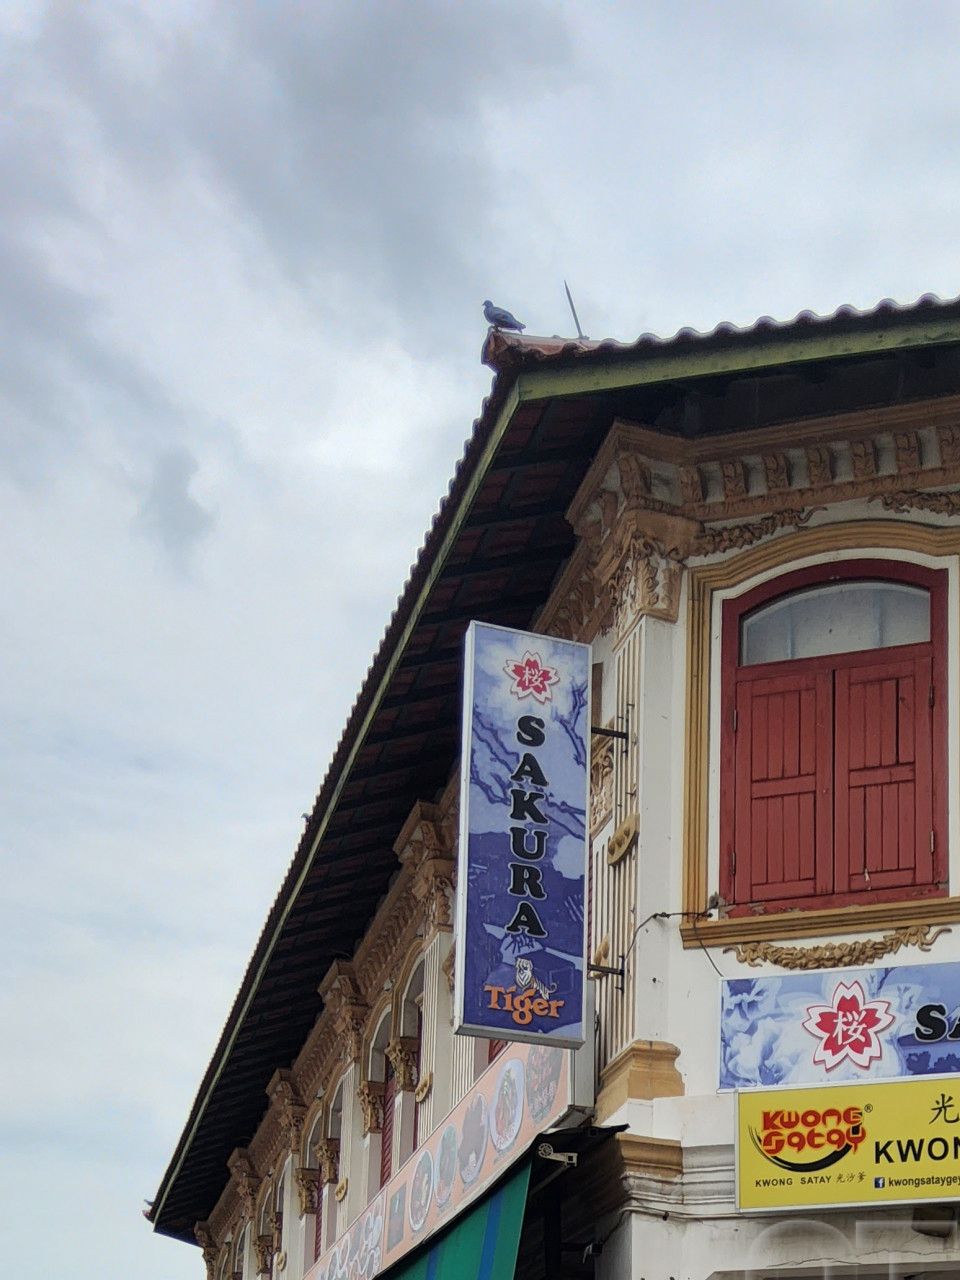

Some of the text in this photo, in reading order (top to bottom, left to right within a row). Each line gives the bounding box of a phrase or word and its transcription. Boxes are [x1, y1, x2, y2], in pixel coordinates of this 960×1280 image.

[506, 714, 549, 938] SAKURA
[484, 984, 564, 1024] Tiger
[755, 1175, 832, 1188] KWONG SATAY
